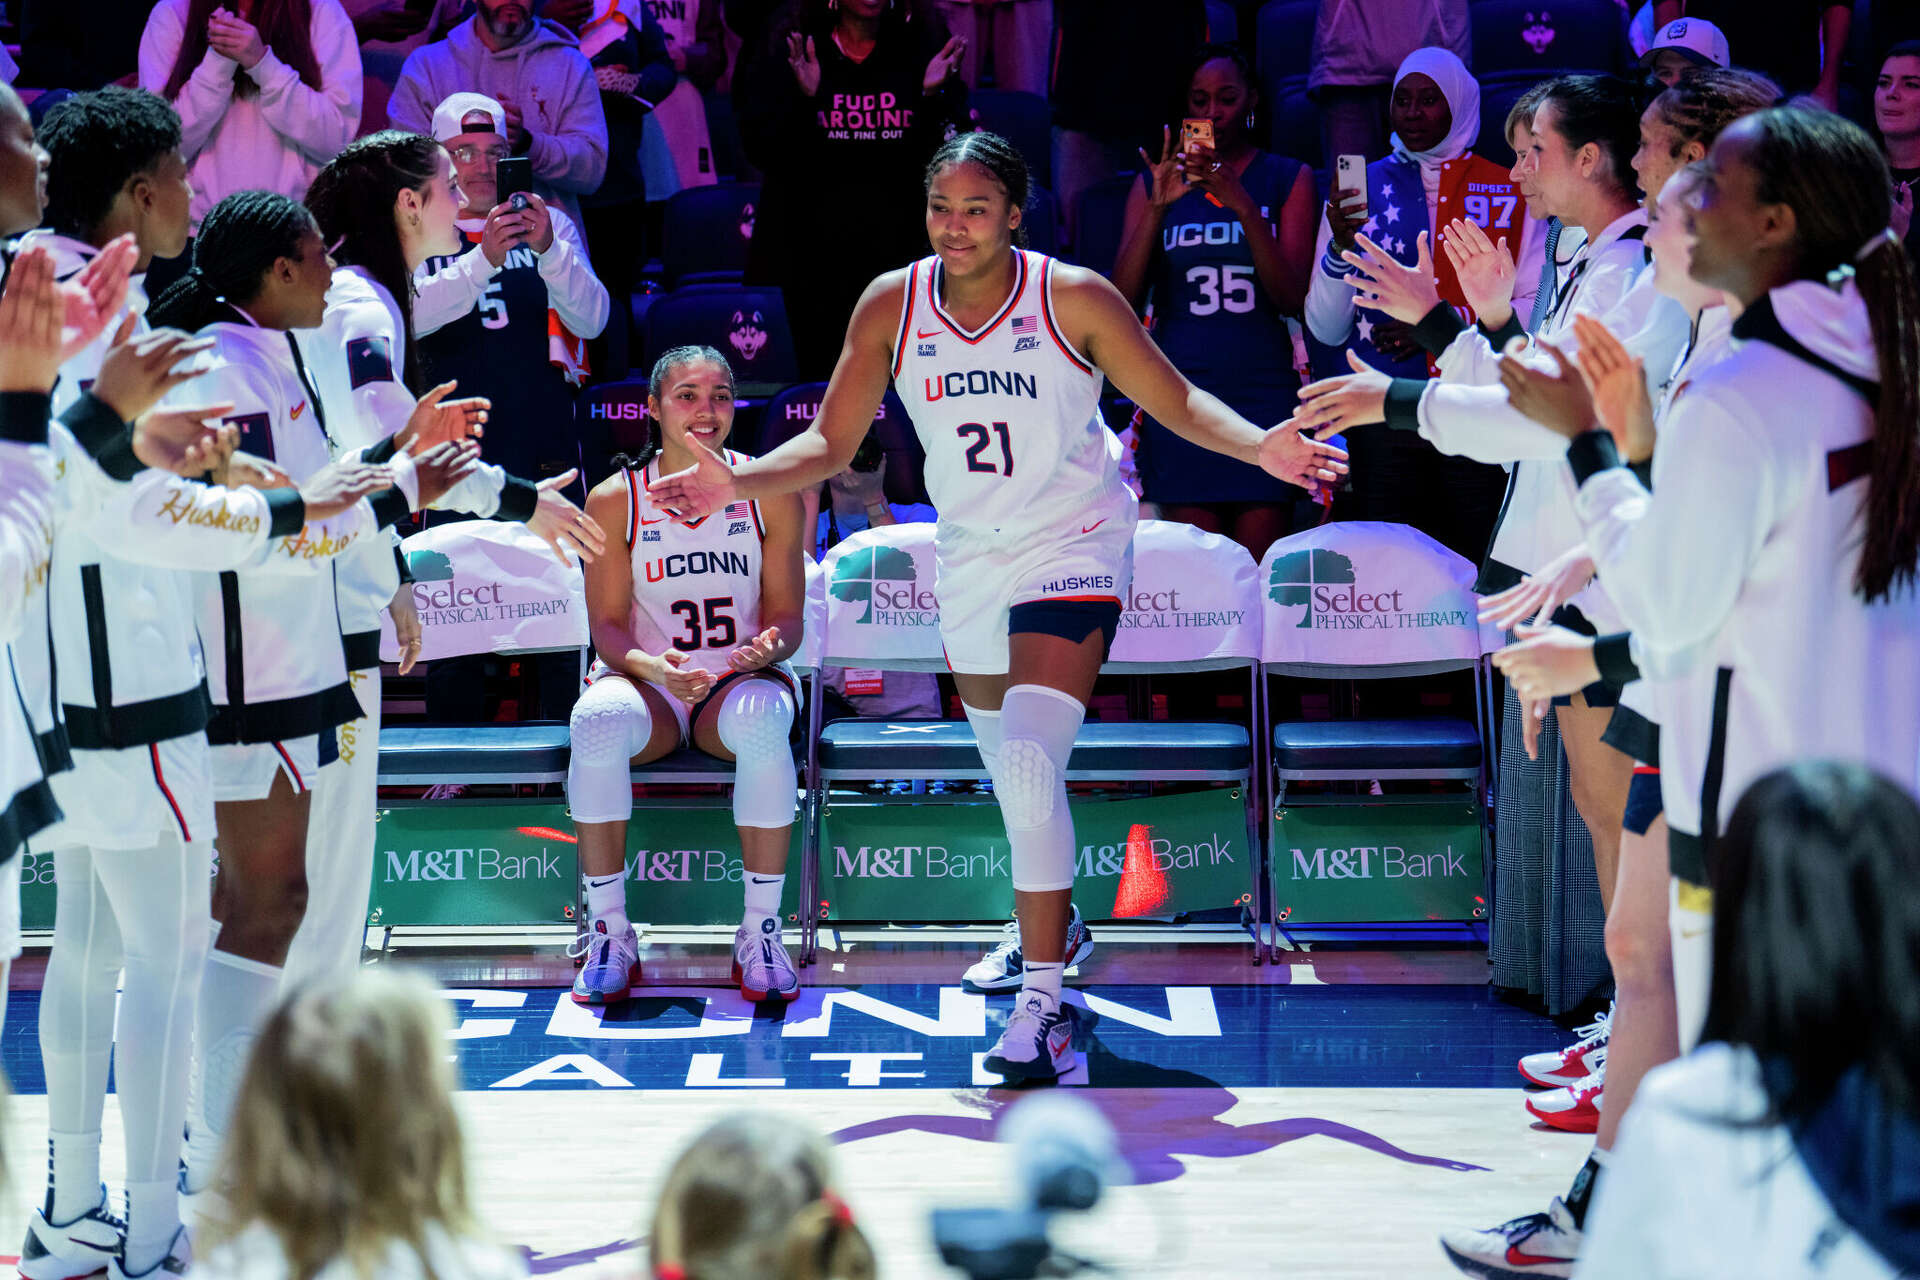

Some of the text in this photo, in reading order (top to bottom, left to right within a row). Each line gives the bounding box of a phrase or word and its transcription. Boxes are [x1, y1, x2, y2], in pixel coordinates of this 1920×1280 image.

[833, 92, 896, 111] FUDD
[881, 129, 903, 139] OUT
[1468, 182, 1513, 193] DIPSET
[1464, 194, 1518, 228] 97
[1163, 221, 1247, 251] UCON
[1186, 265, 1255, 316] 35
[1013, 341, 1041, 353] EAST
[925, 369, 1038, 402] UCONN
[591, 403, 650, 420] HUSK
[956, 421, 1014, 478] 21
[156, 488, 260, 534] Huskies
[727, 525, 752, 537] EAST
[645, 551, 749, 583] UCONN
[413, 581, 504, 611] Select
[874, 581, 941, 610] Sele
[1042, 575, 1113, 593] HUSKIES
[1126, 583, 1181, 612] lect
[495, 599, 569, 620] THERAPY
[1313, 585, 1403, 613] Select
[670, 596, 737, 652] 35
[876, 610, 941, 627] PHYSICA
[1117, 610, 1245, 629] YSICAL THERAPY
[1315, 611, 1469, 630] PHYSICAL THERAPY
[384, 847, 561, 882] M&T Bank
[704, 850, 745, 882] Ba
[833, 846, 1009, 878] M&T Bank
[1149, 832, 1235, 872] Bank
[1289, 845, 1468, 880] M&T Bank
